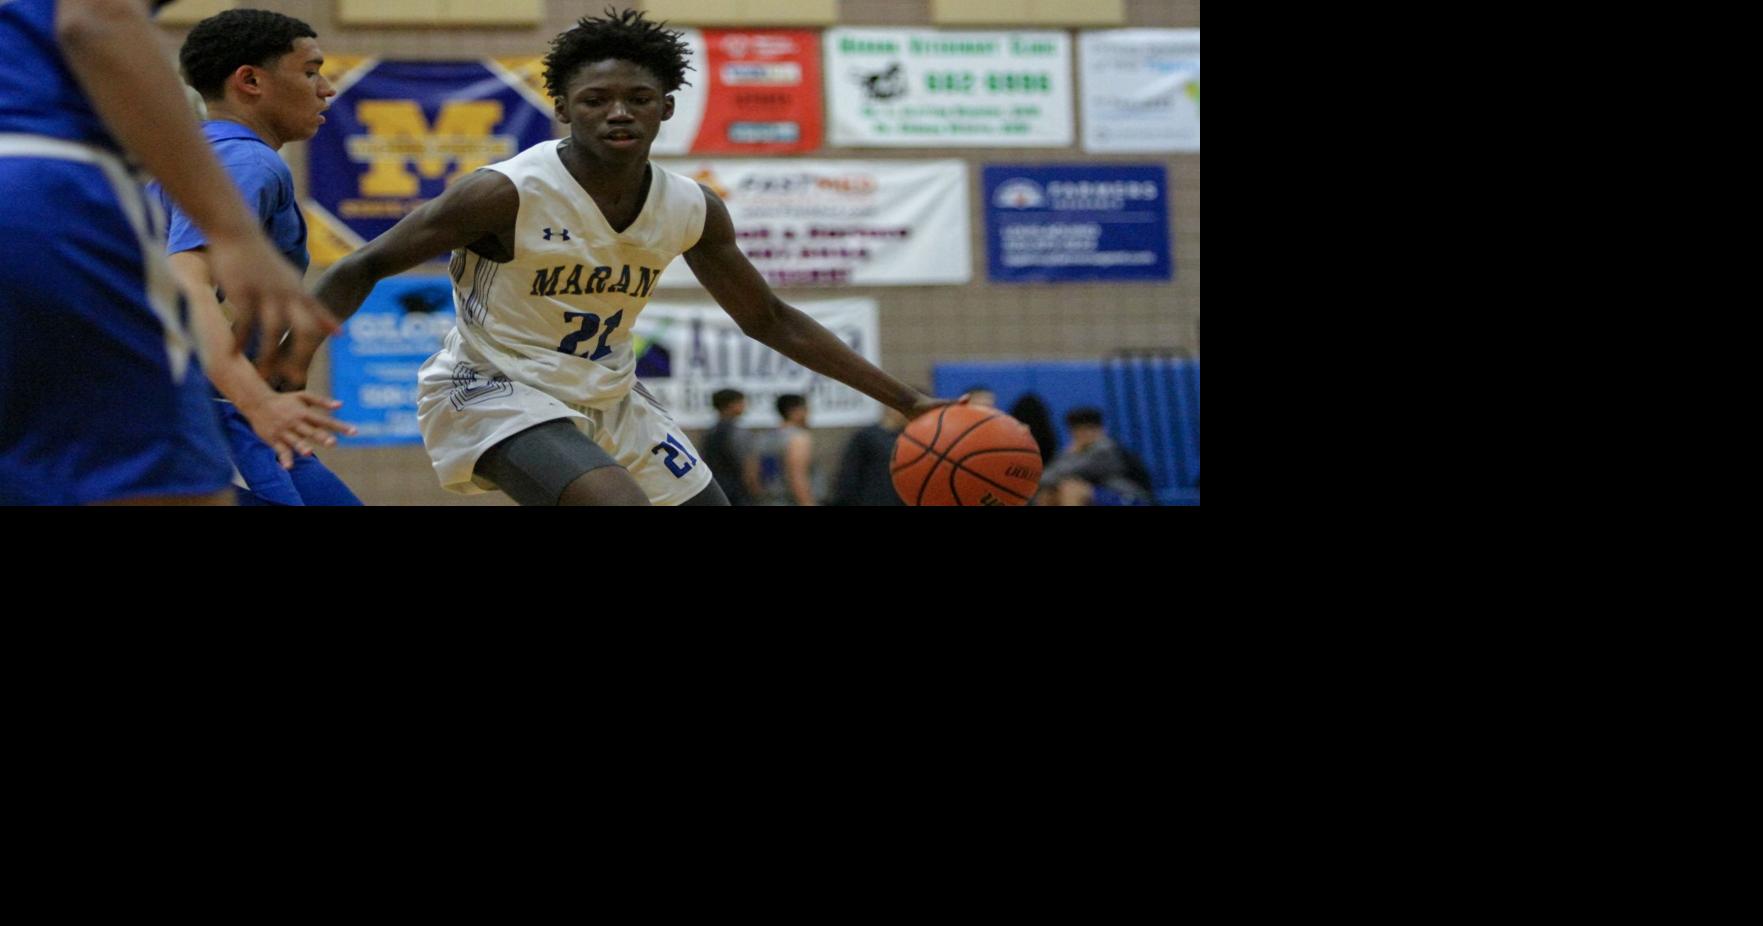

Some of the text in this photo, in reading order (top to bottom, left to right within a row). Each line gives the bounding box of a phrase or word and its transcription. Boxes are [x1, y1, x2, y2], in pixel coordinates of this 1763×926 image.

[356, 99, 504, 198] M
[557, 309, 623, 361] 21
[651, 432, 697, 478] 21
